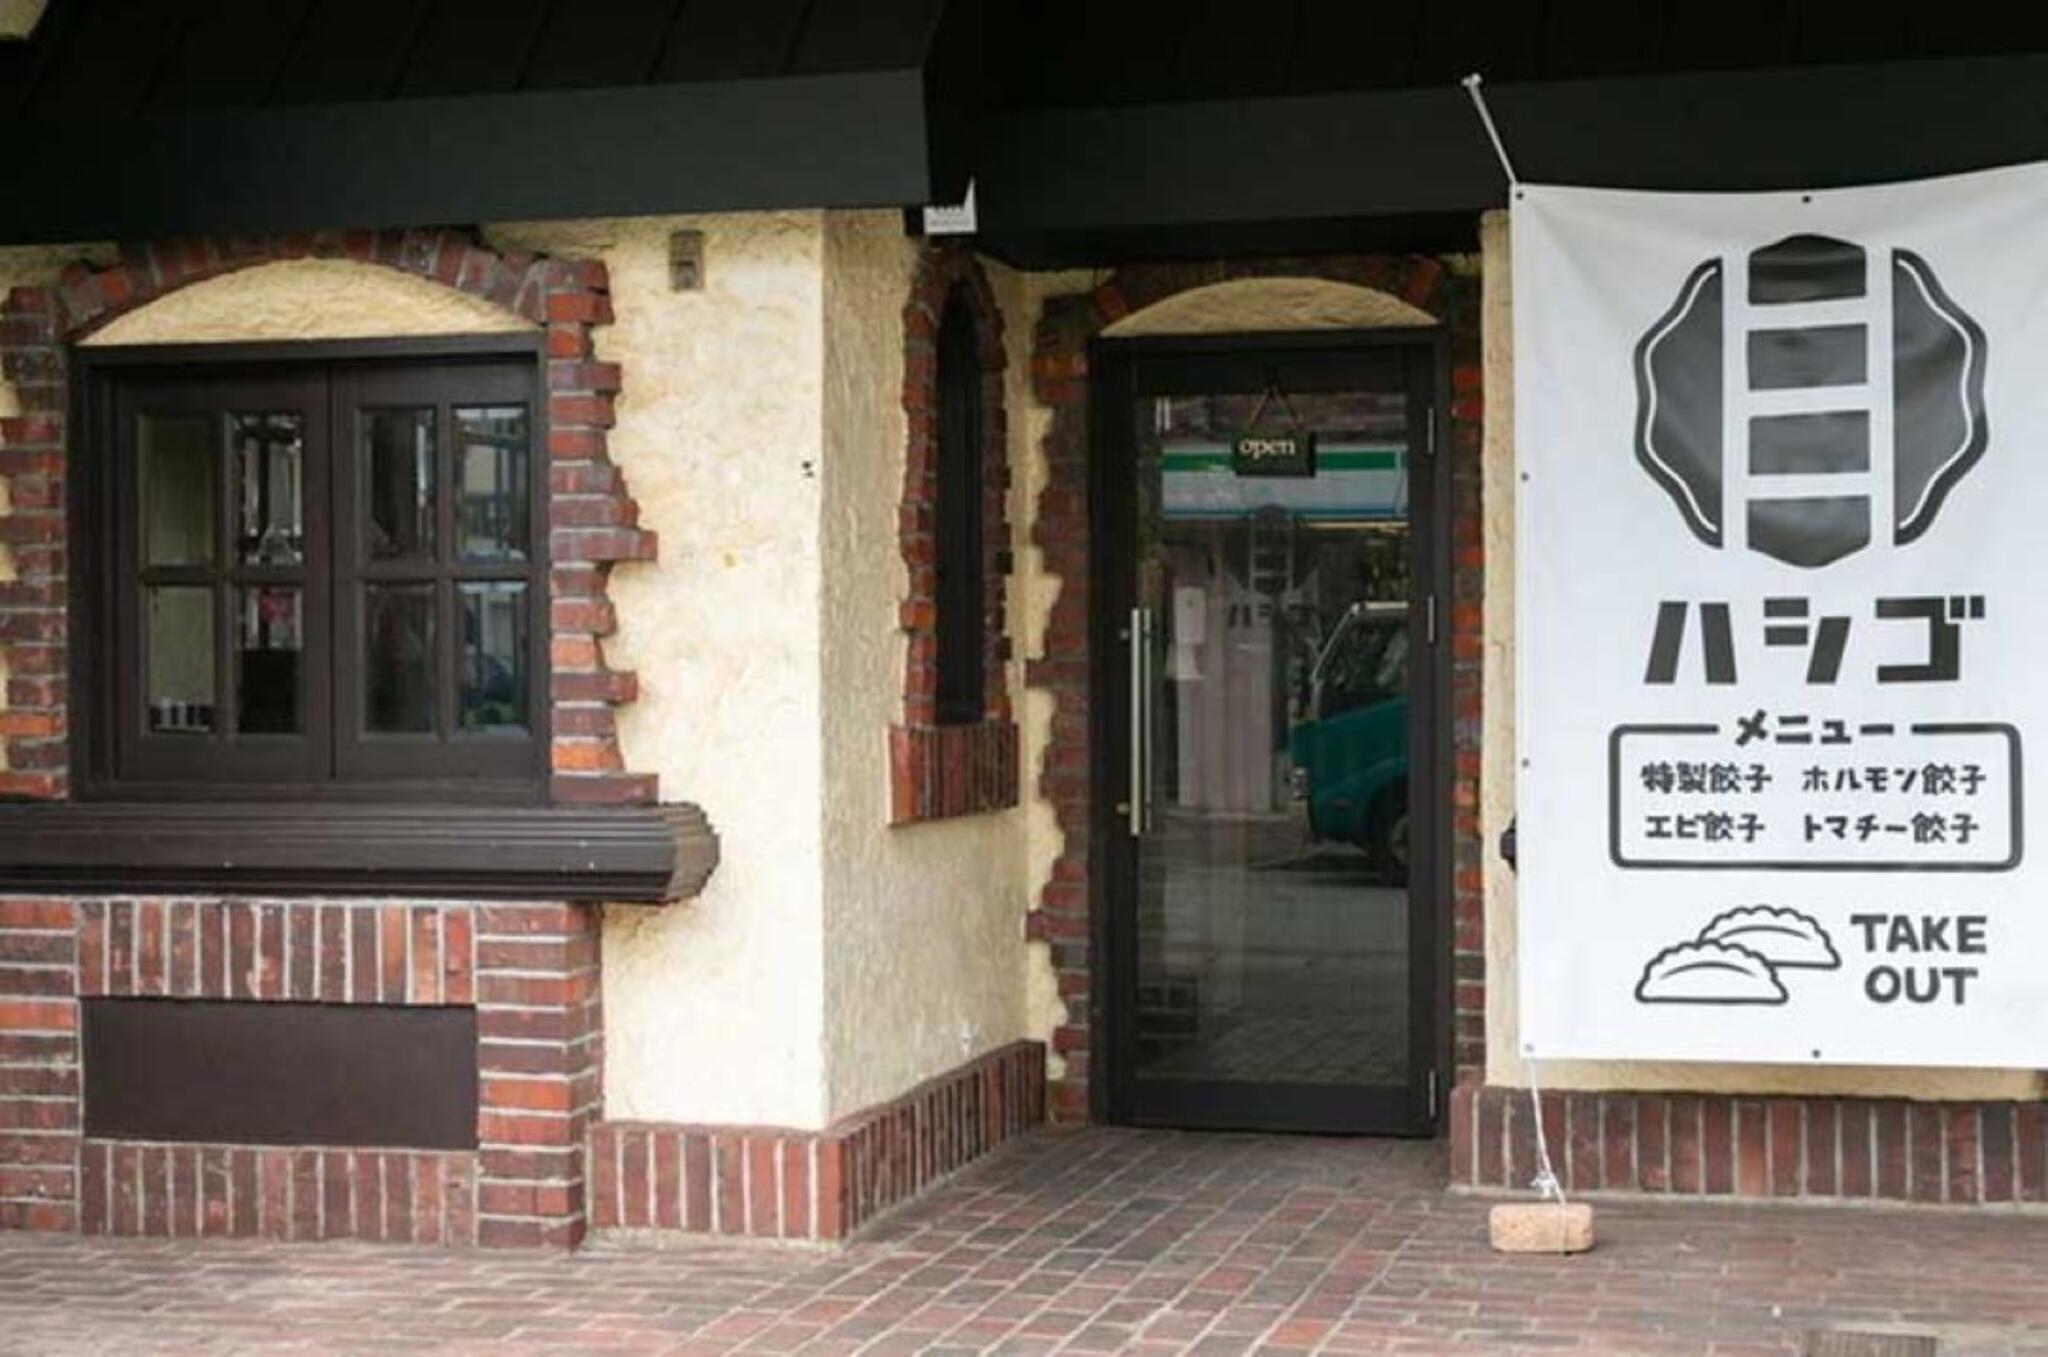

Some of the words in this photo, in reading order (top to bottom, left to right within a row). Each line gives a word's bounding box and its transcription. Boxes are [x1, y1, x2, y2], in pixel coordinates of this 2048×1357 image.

[1239, 440, 1295, 459] open
[1644, 596, 1985, 684] ハシゴ
[1735, 709, 1894, 746] メニュー
[1640, 761, 1772, 794] 特製餃子
[1802, 762, 1986, 795] ホルモン餃子
[1645, 810, 1765, 843] エビ餃子
[1805, 812, 1979, 844] トマチー餃子
[1851, 914, 1987, 953] TAKE
[1865, 966, 1978, 1004] OUT
